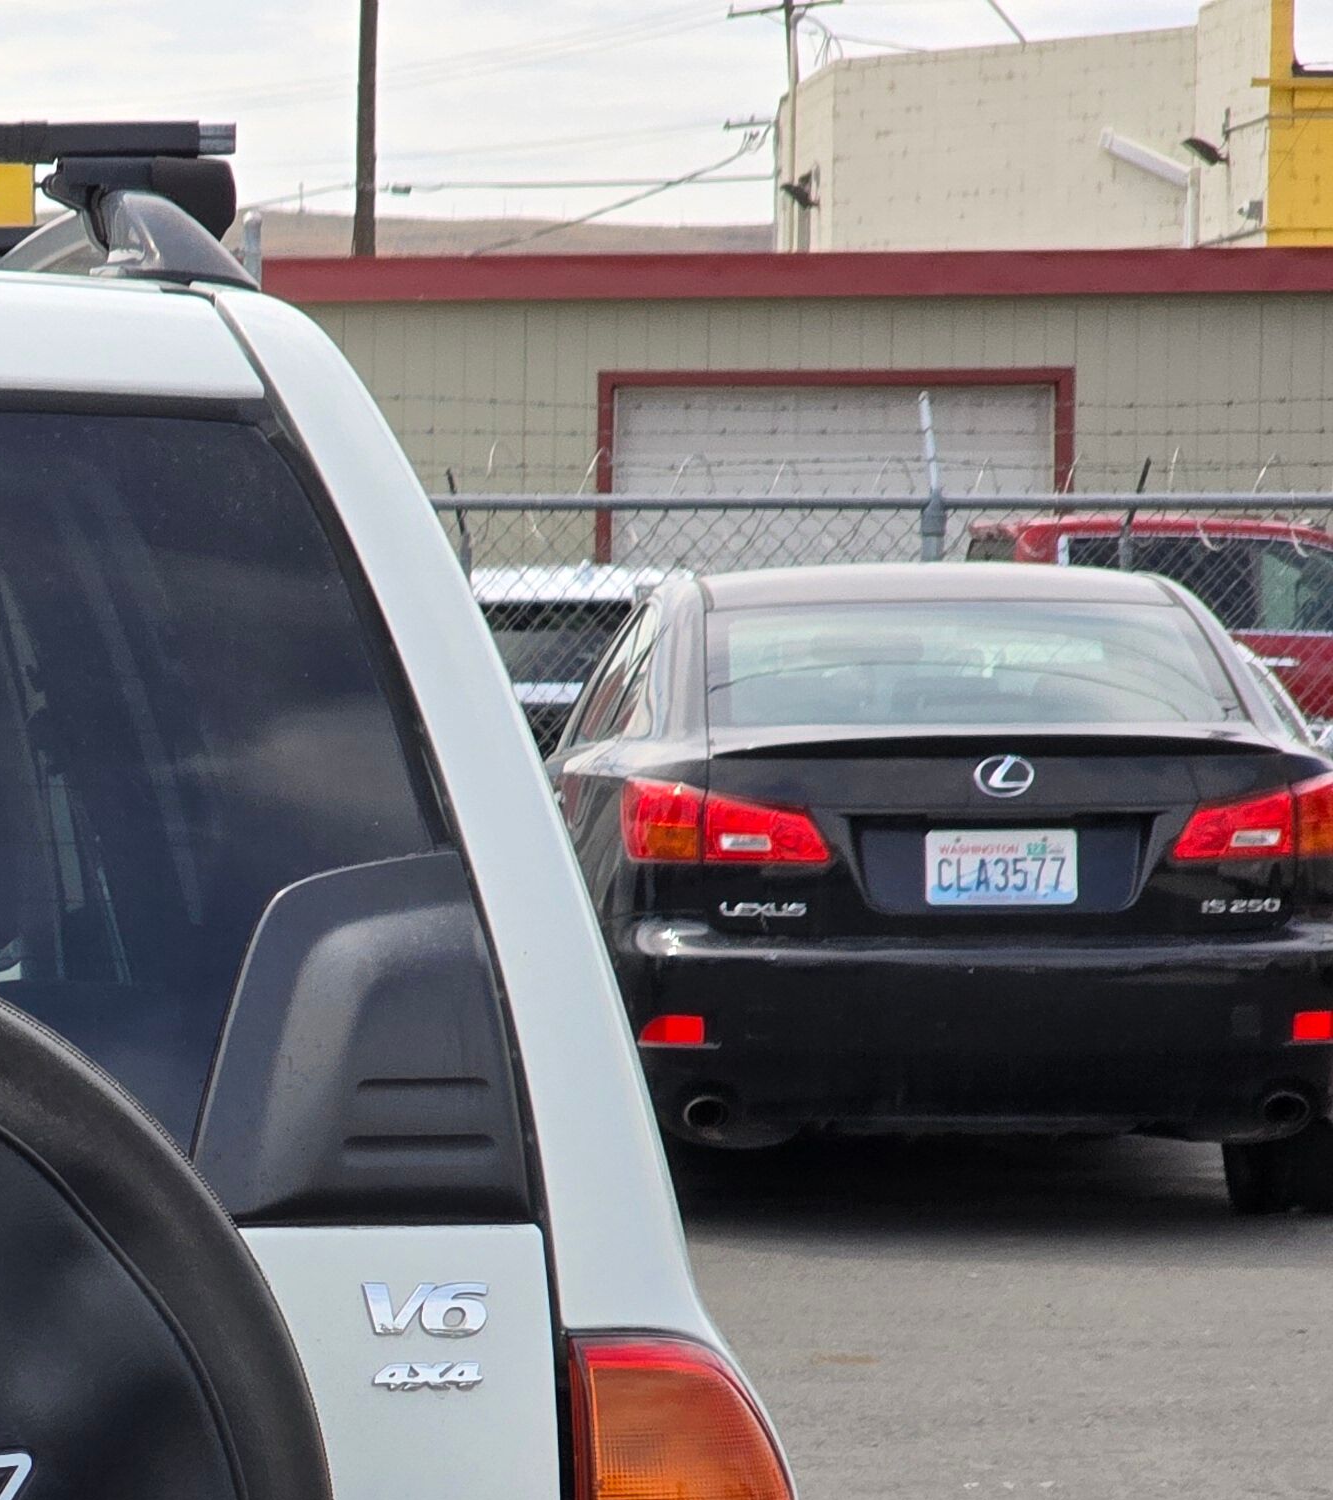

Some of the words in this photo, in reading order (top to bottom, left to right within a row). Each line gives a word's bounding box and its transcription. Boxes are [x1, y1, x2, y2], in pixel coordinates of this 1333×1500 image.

[937, 857, 1066, 892] CLA3577
[719, 901, 807, 917] LEXUS
[1201, 899, 1226, 914] IS
[1229, 898, 1281, 913] 250
[361, 1281, 488, 1339] V6
